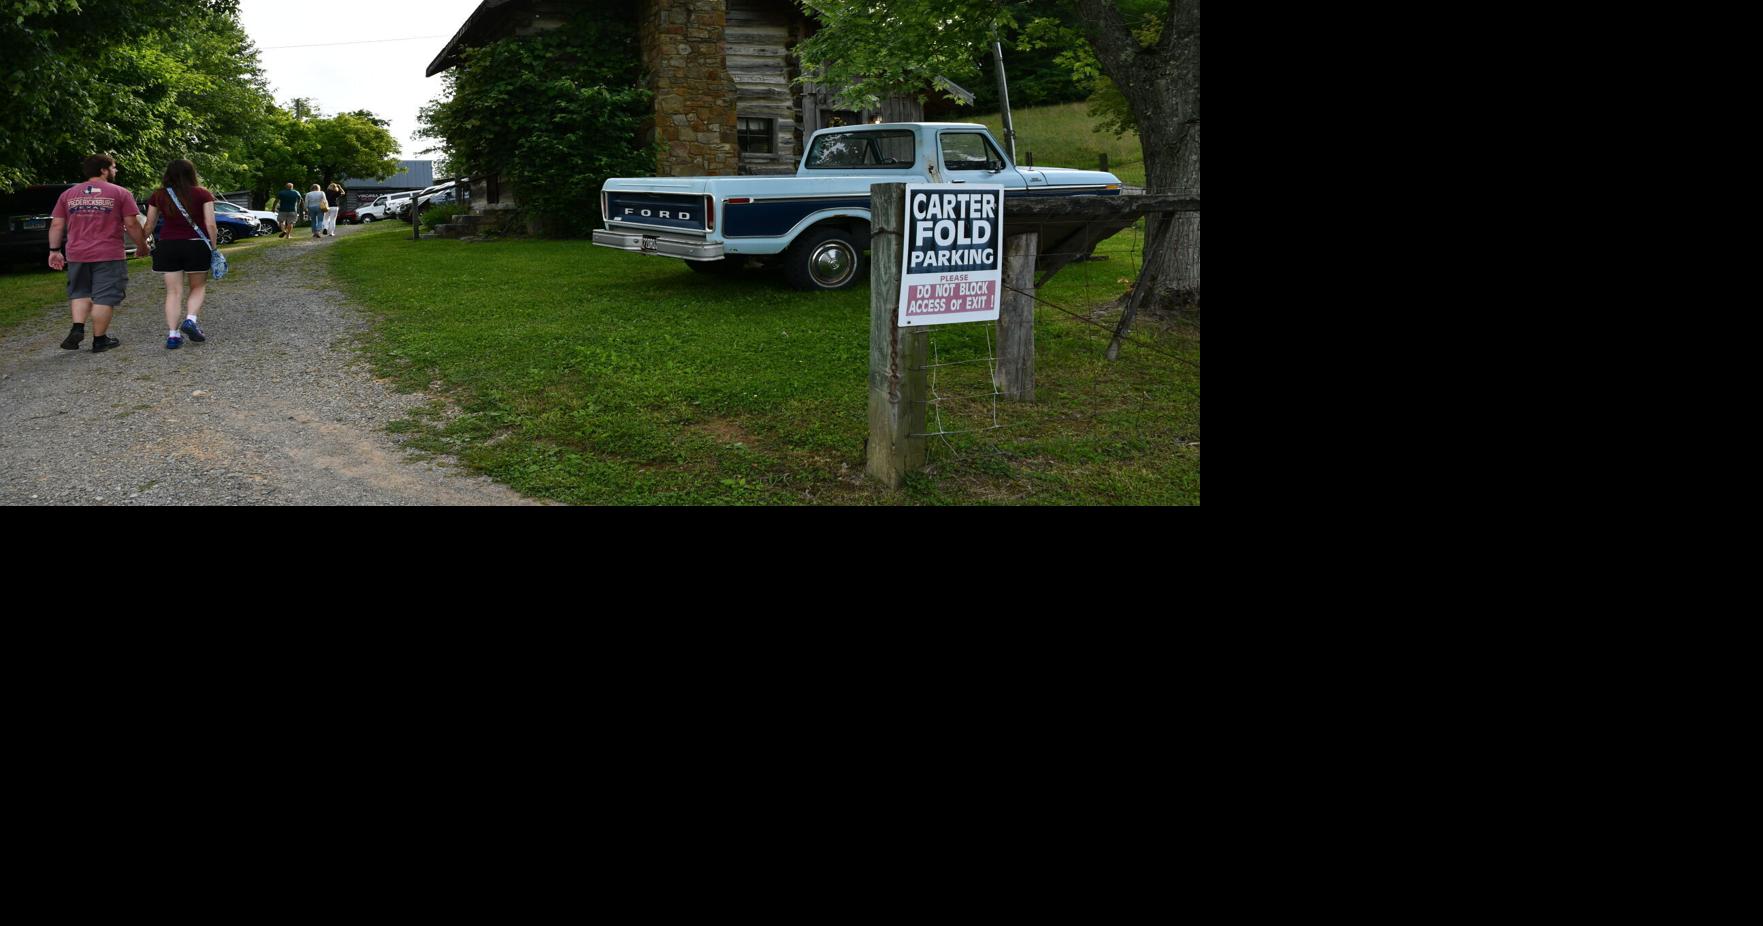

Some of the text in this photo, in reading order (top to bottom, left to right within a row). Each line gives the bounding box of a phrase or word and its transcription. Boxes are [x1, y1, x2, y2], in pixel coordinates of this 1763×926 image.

[625, 208, 690, 220] FORD
[913, 193, 995, 219] CARTER
[916, 220, 991, 246] FOLD
[911, 248, 994, 267] PARKING
[940, 274, 968, 282] PLEASE
[916, 281, 988, 298] DO NOT BLOCK
[908, 299, 945, 313] ACCESS
[950, 299, 962, 311] or
[966, 296, 987, 309] EXIT
